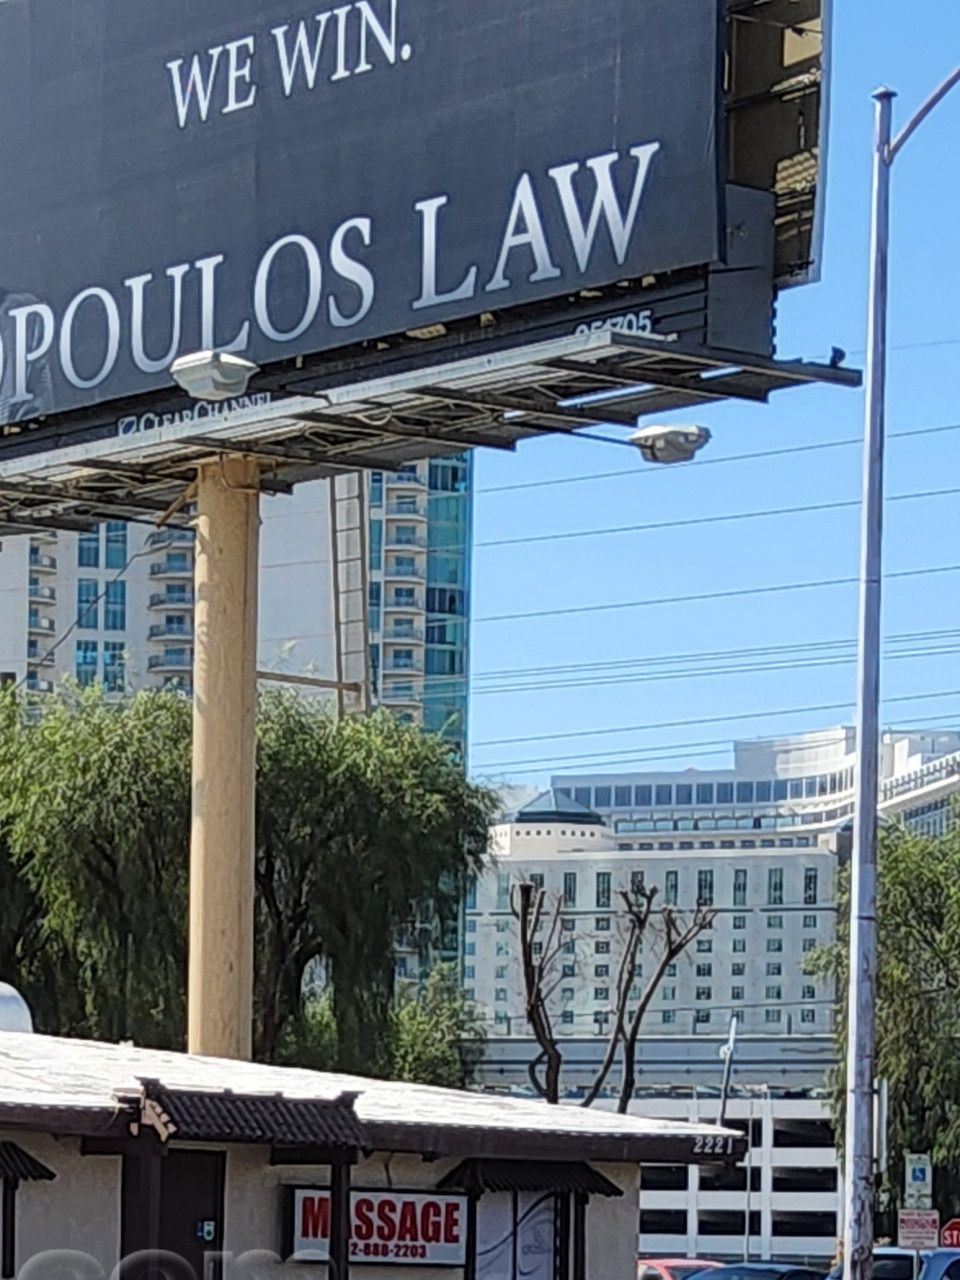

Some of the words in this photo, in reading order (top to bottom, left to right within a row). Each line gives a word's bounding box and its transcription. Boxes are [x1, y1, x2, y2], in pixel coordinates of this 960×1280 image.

[166, 36, 258, 130] WE
[271, 0, 412, 97] WIN.
[412, 141, 661, 311] LAW
[692, 1135, 733, 1155] 2221
[301, 1196, 460, 1244] MSSAGE
[350, 1242, 427, 1259] 2-888-2203
[943, 1229, 960, 1246] ST
